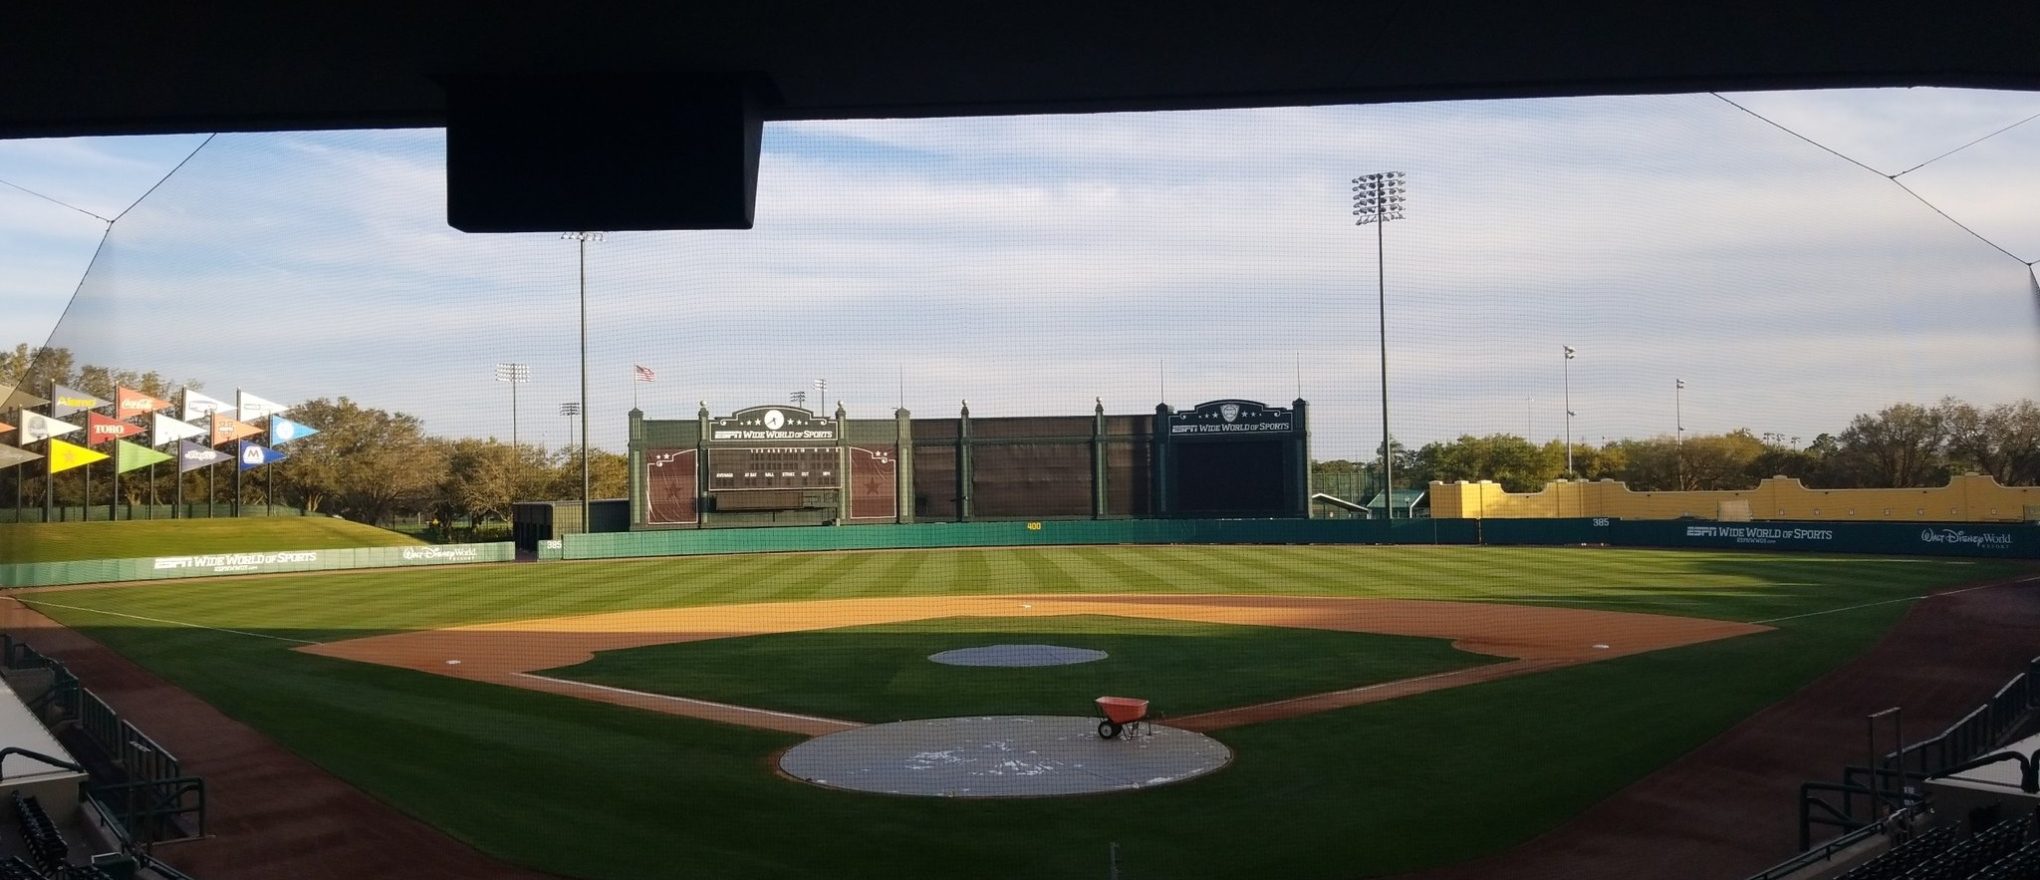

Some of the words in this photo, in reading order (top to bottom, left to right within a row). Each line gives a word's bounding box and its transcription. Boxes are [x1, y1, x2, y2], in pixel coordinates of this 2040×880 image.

[94, 424, 124, 434] TORO
[1172, 424, 1198, 433] ESPN
[1200, 424, 1222, 432] WIDE
[1222, 423, 1250, 432] WORLD
[1259, 422, 1290, 431] SPORTS
[714, 431, 742, 439] ESPN
[743, 431, 765, 439] WIDE
[765, 430, 794, 439] WORLD
[803, 430, 833, 438] SPORTS
[1027, 522, 1041, 530] 400
[1592, 518, 1610, 527] 385
[1686, 526, 1717, 537] ESPN
[1719, 527, 1745, 537] WIDE
[1746, 528, 1781, 539] WORLD
[1794, 528, 1833, 540] SPORTS
[546, 540, 562, 549] 385
[154, 557, 193, 569] ESPN
[194, 556, 225, 568] WIDE
[226, 554, 265, 566] WORLD
[277, 552, 318, 563] SPORTS
